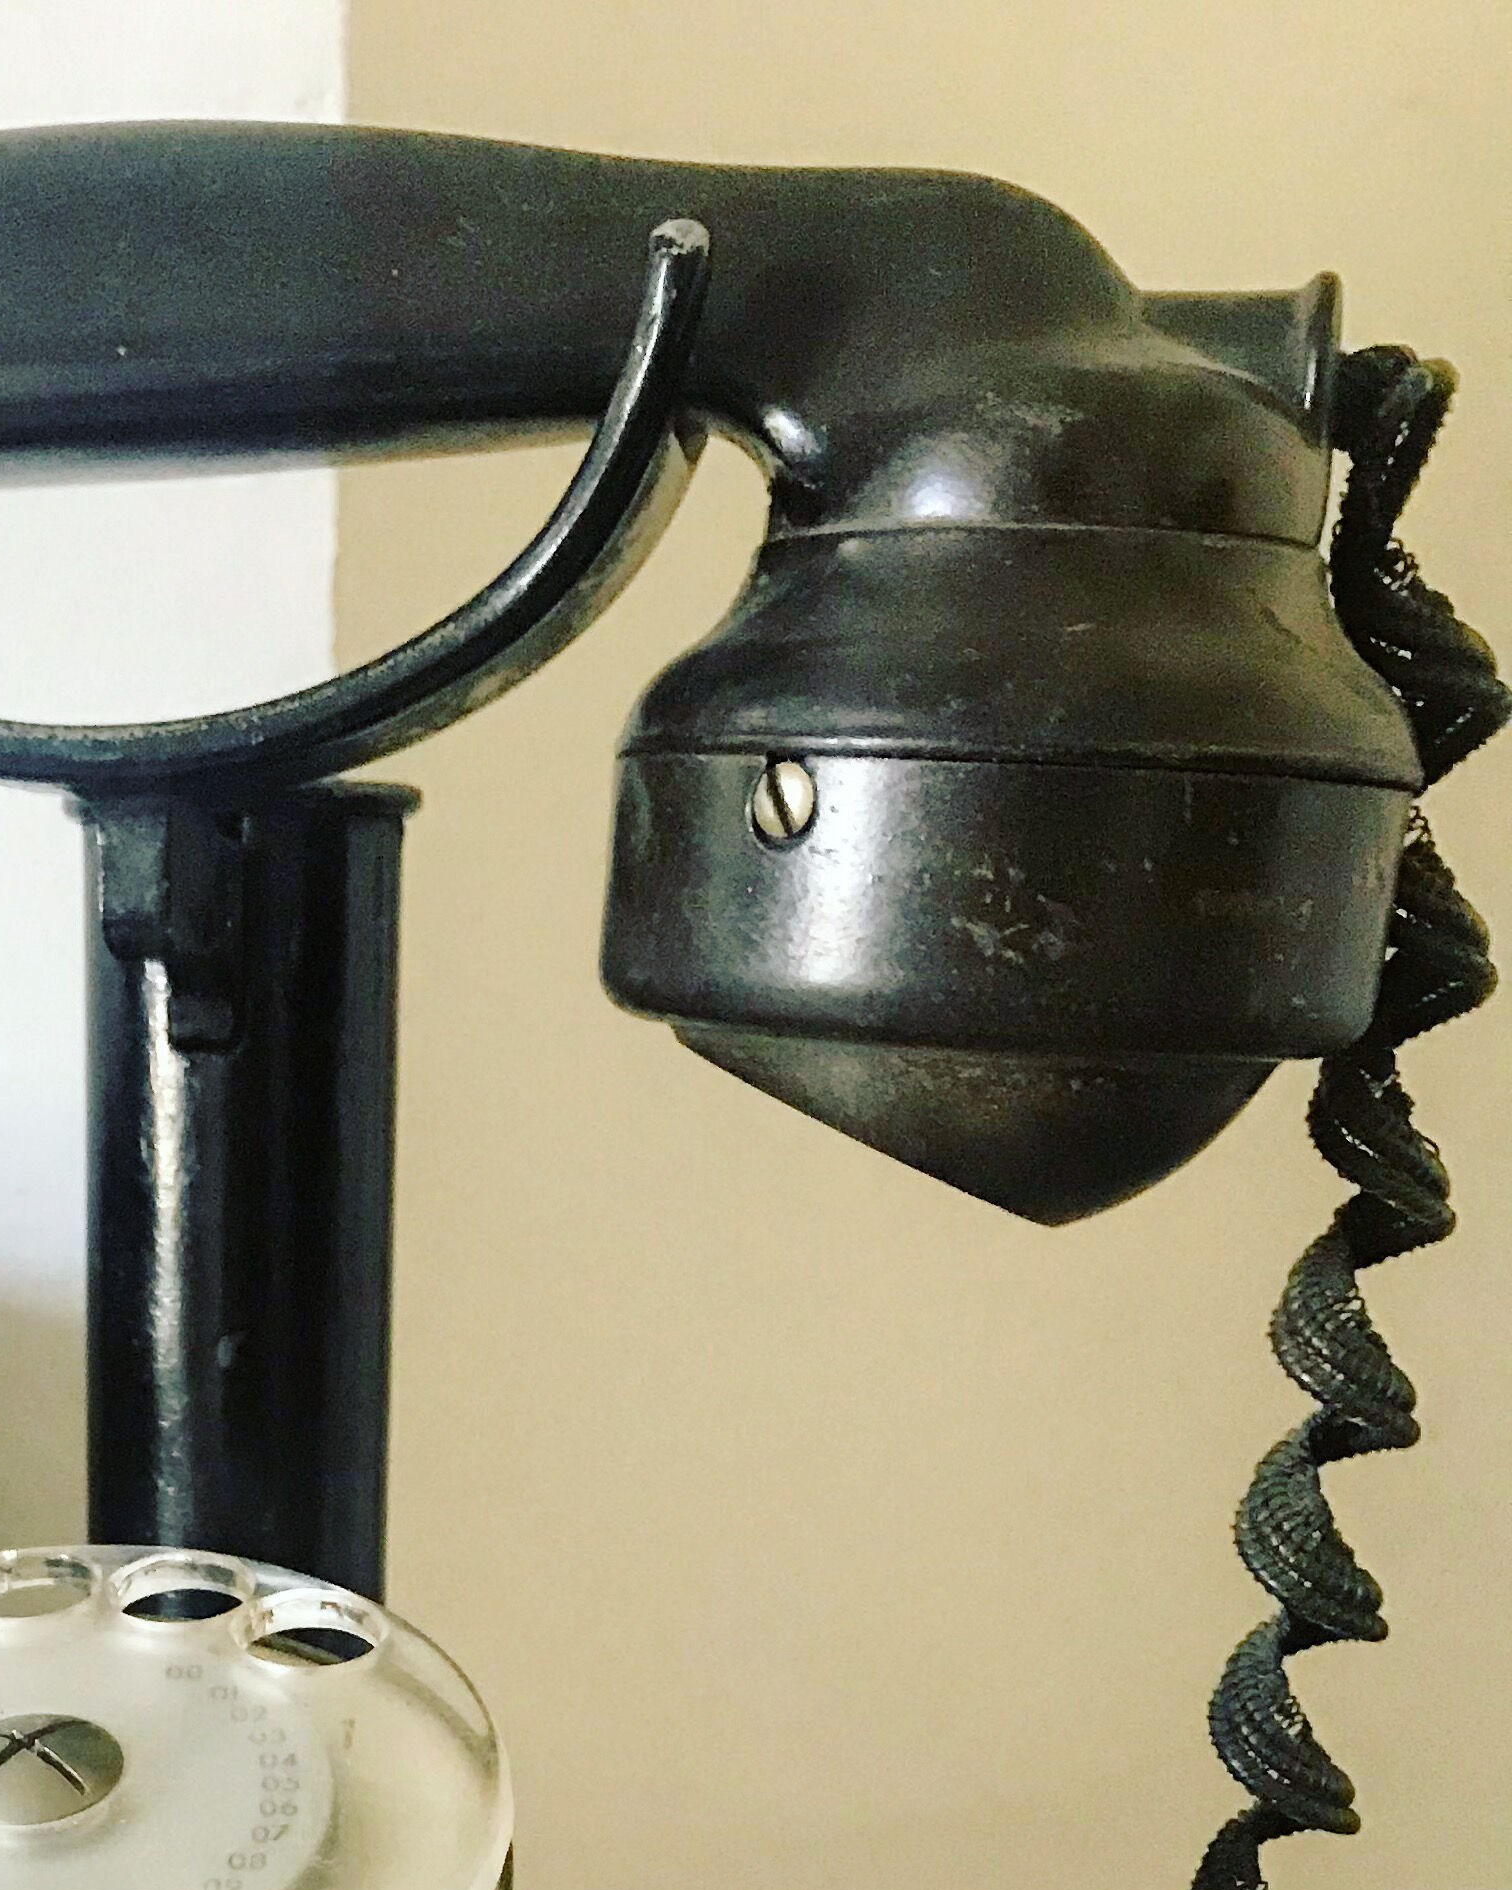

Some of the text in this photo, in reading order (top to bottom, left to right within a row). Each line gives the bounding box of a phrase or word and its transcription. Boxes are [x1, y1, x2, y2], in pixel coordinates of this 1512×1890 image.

[230, 1704, 268, 1722] 02
[248, 1727, 287, 1745] 03
[258, 1752, 299, 1769] 04
[261, 1775, 301, 1793] 05
[259, 1799, 299, 1817] 06
[251, 1823, 291, 1844] 07
[227, 1852, 267, 1871] 08
